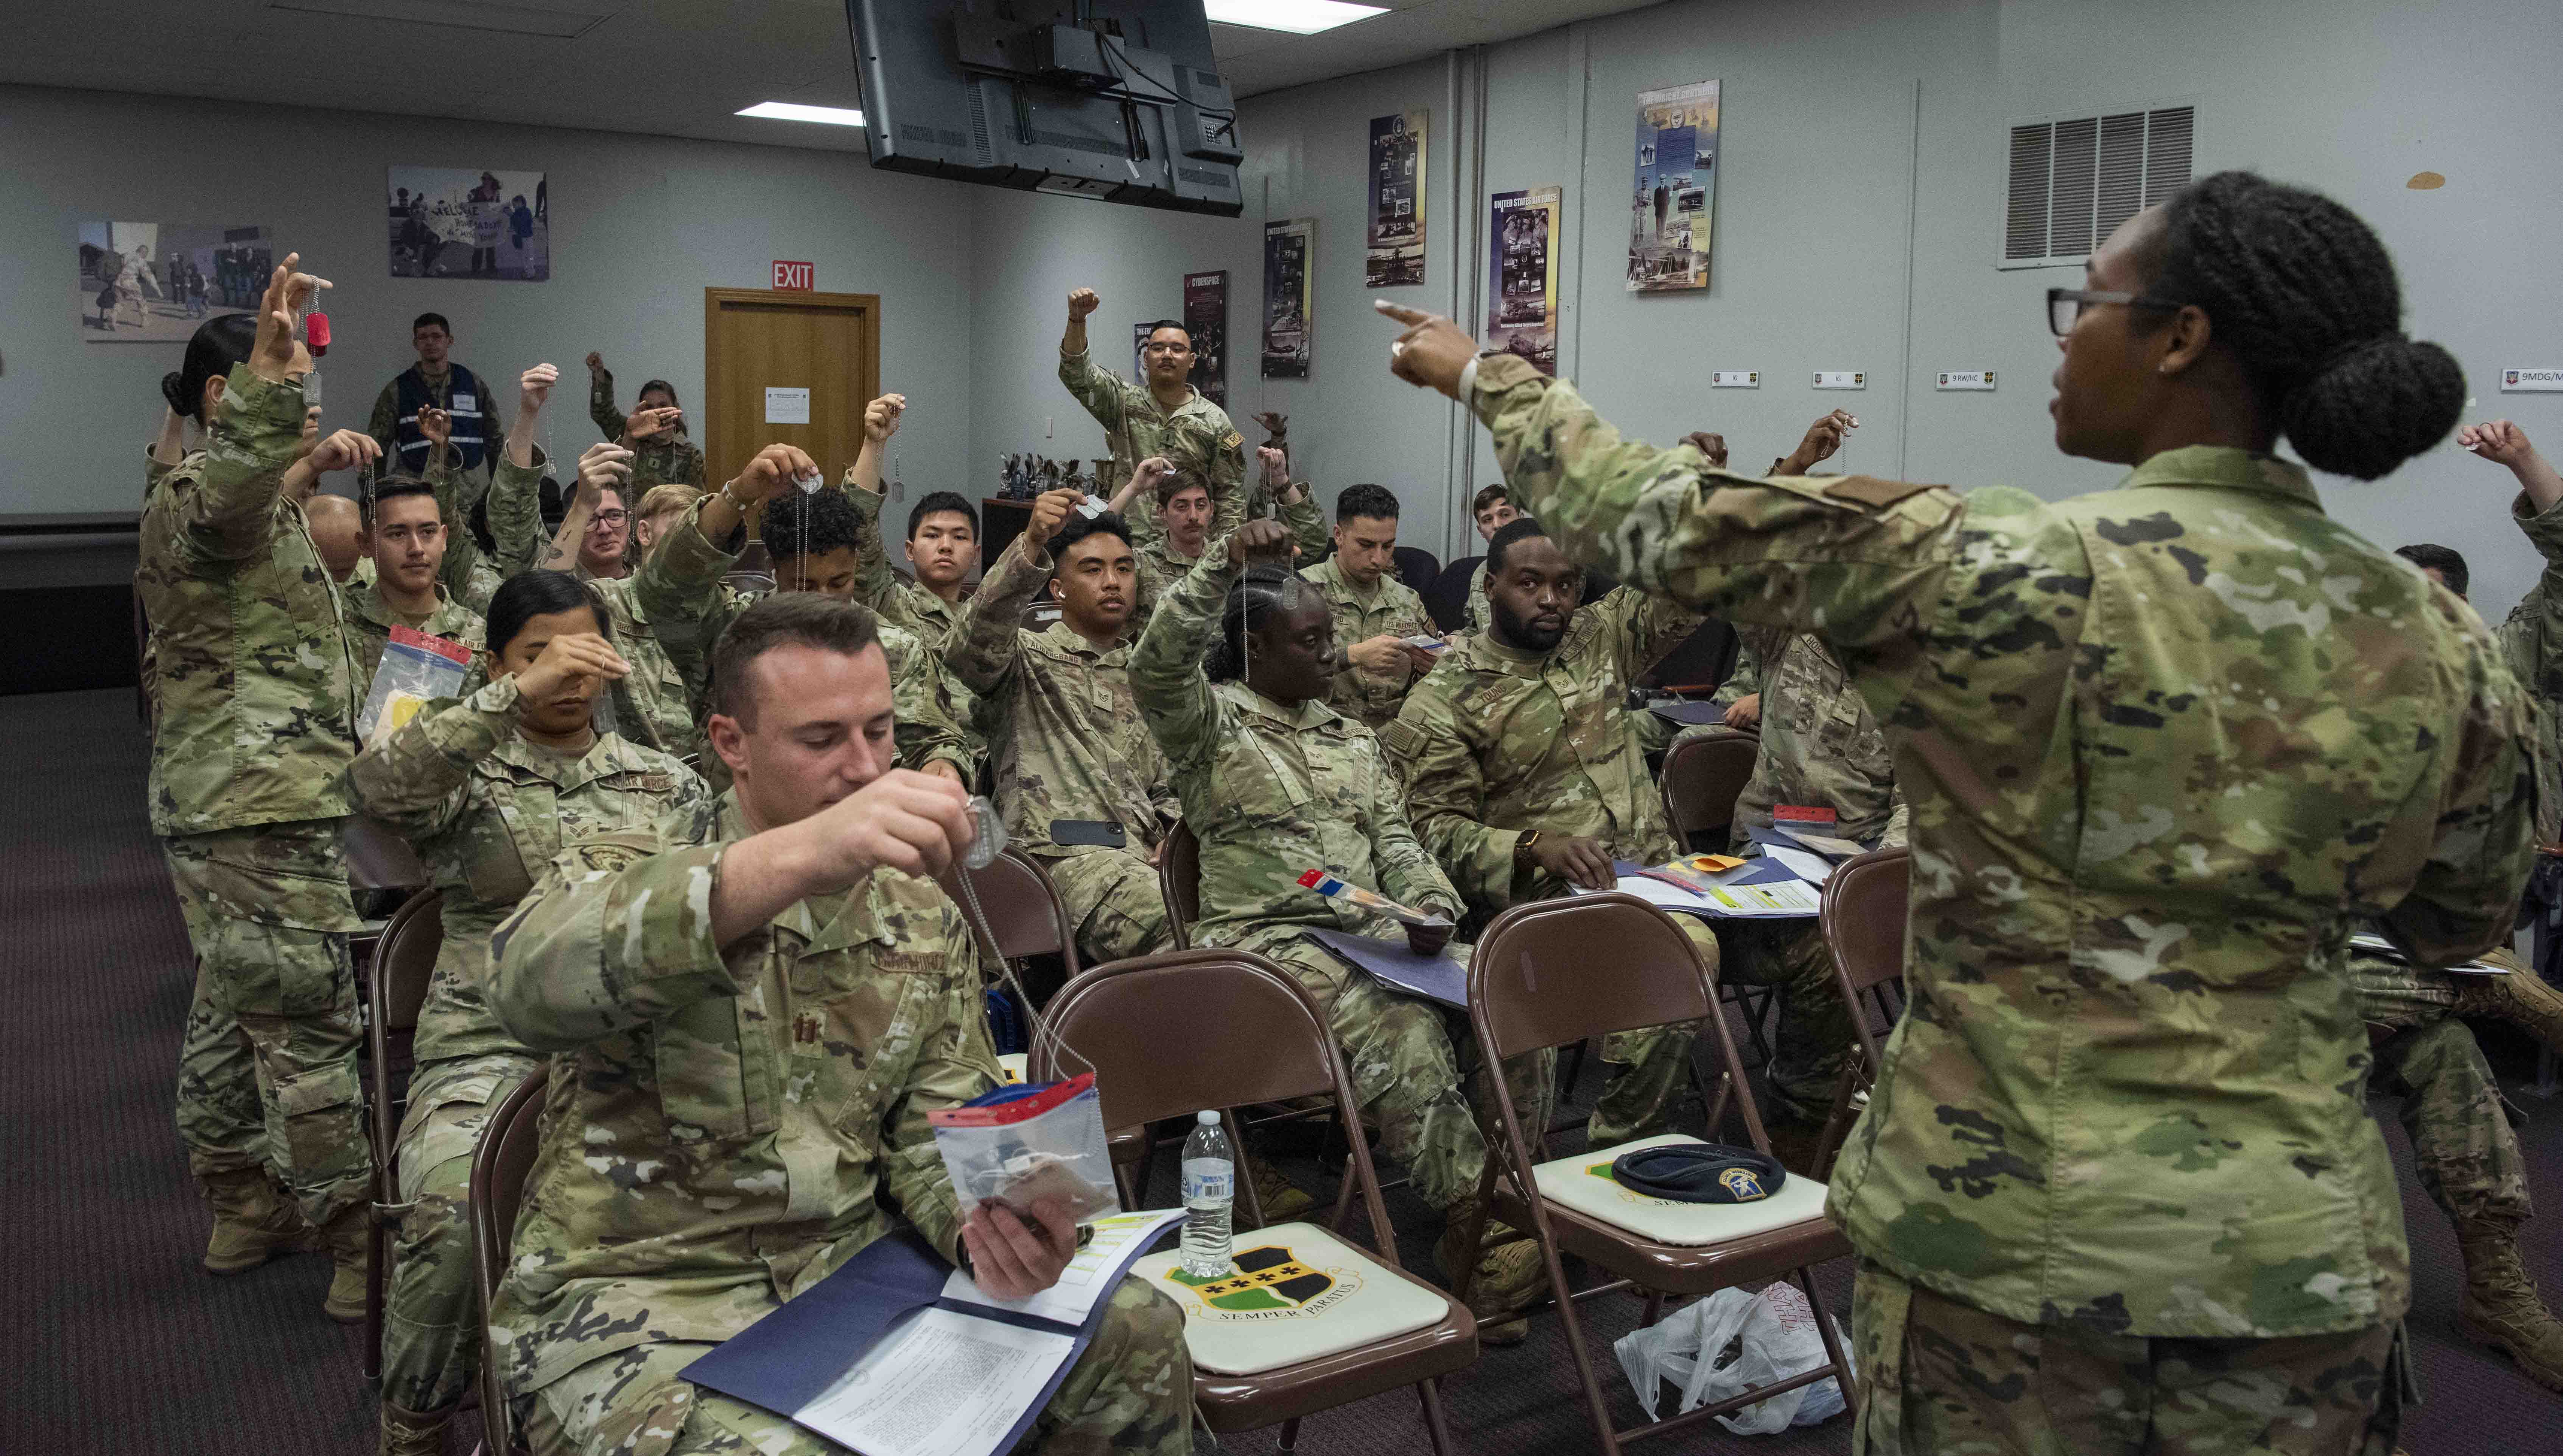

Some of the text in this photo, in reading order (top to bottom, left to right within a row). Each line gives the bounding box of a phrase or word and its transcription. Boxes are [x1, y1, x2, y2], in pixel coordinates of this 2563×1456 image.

[1494, 193, 1557, 208] UNITED STATES AIR FORCE
[1267, 227, 1280, 235] UNITED
[775, 264, 812, 288] EXIT
[1192, 275, 1220, 287] CYBERSPACE
[618, 623, 644, 635] BROWN
[464, 639, 474, 649] AIR
[1478, 685, 1508, 703] YOUNG
[1346, 726, 1373, 737] FORCE
[1220, 1283, 1355, 1320] SEMPER PARATUS
